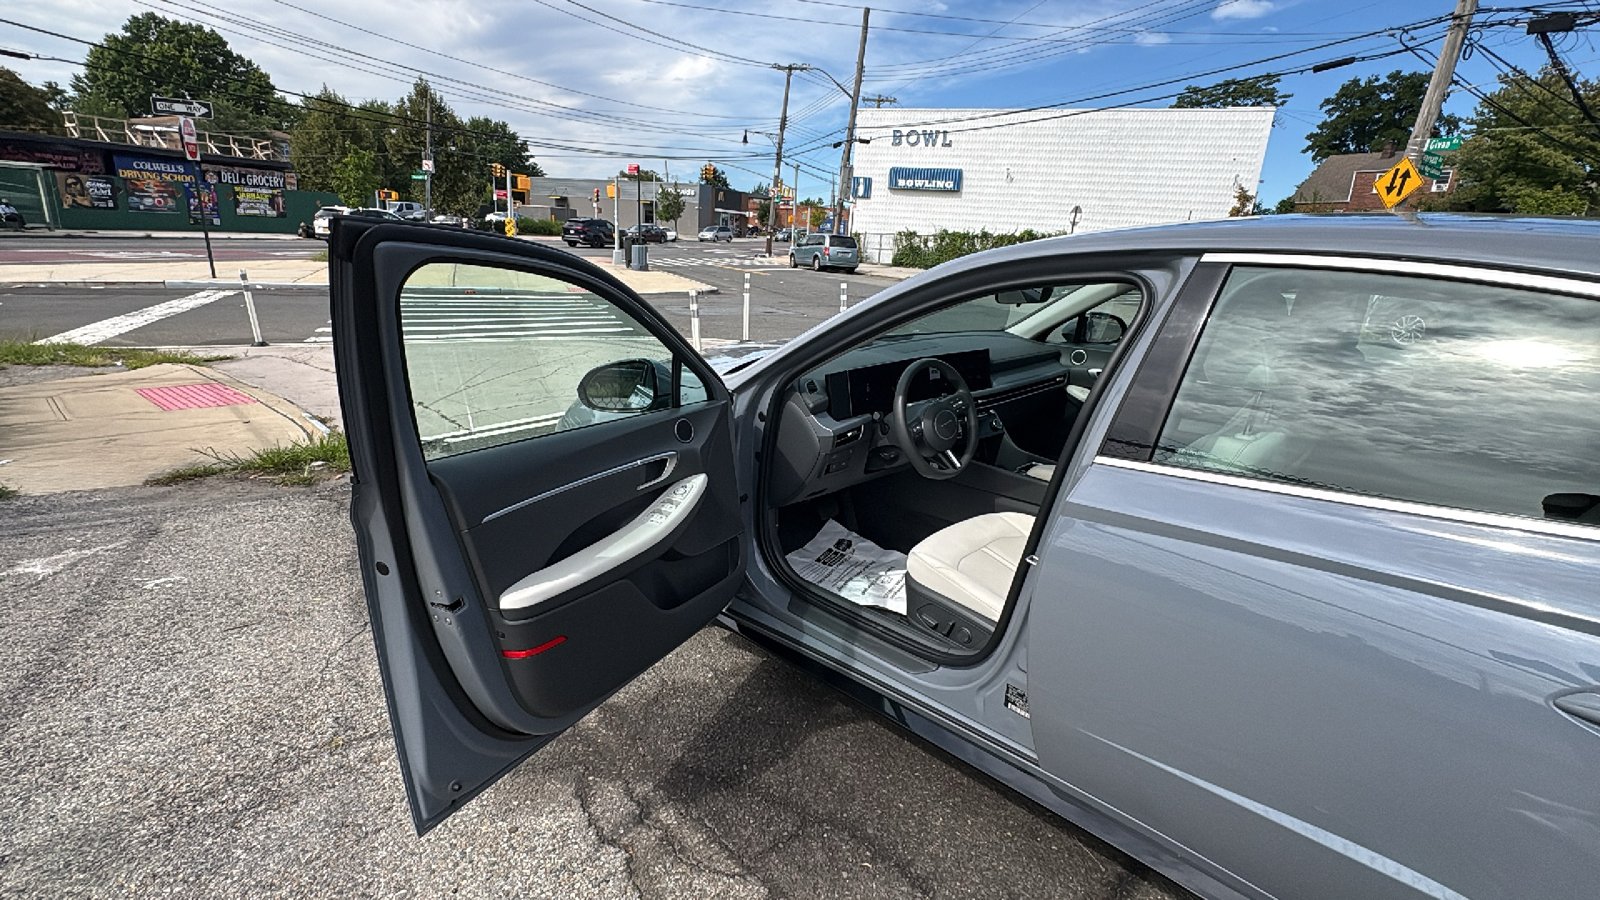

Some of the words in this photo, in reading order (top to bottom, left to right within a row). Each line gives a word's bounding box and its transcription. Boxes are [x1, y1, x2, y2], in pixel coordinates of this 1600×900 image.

[158, 103, 175, 111] ONE
[185, 104, 202, 113] WAY
[891, 130, 953, 147] BOWL
[1430, 139, 1451, 150] Givan
[132, 161, 185, 173] COLWELL'S
[118, 169, 160, 180] DRIVING
[161, 173, 196, 182] SCHOO
[221, 171, 240, 184] DELI
[246, 174, 284, 187] GROCERY
[898, 179, 954, 189] BOWLING
